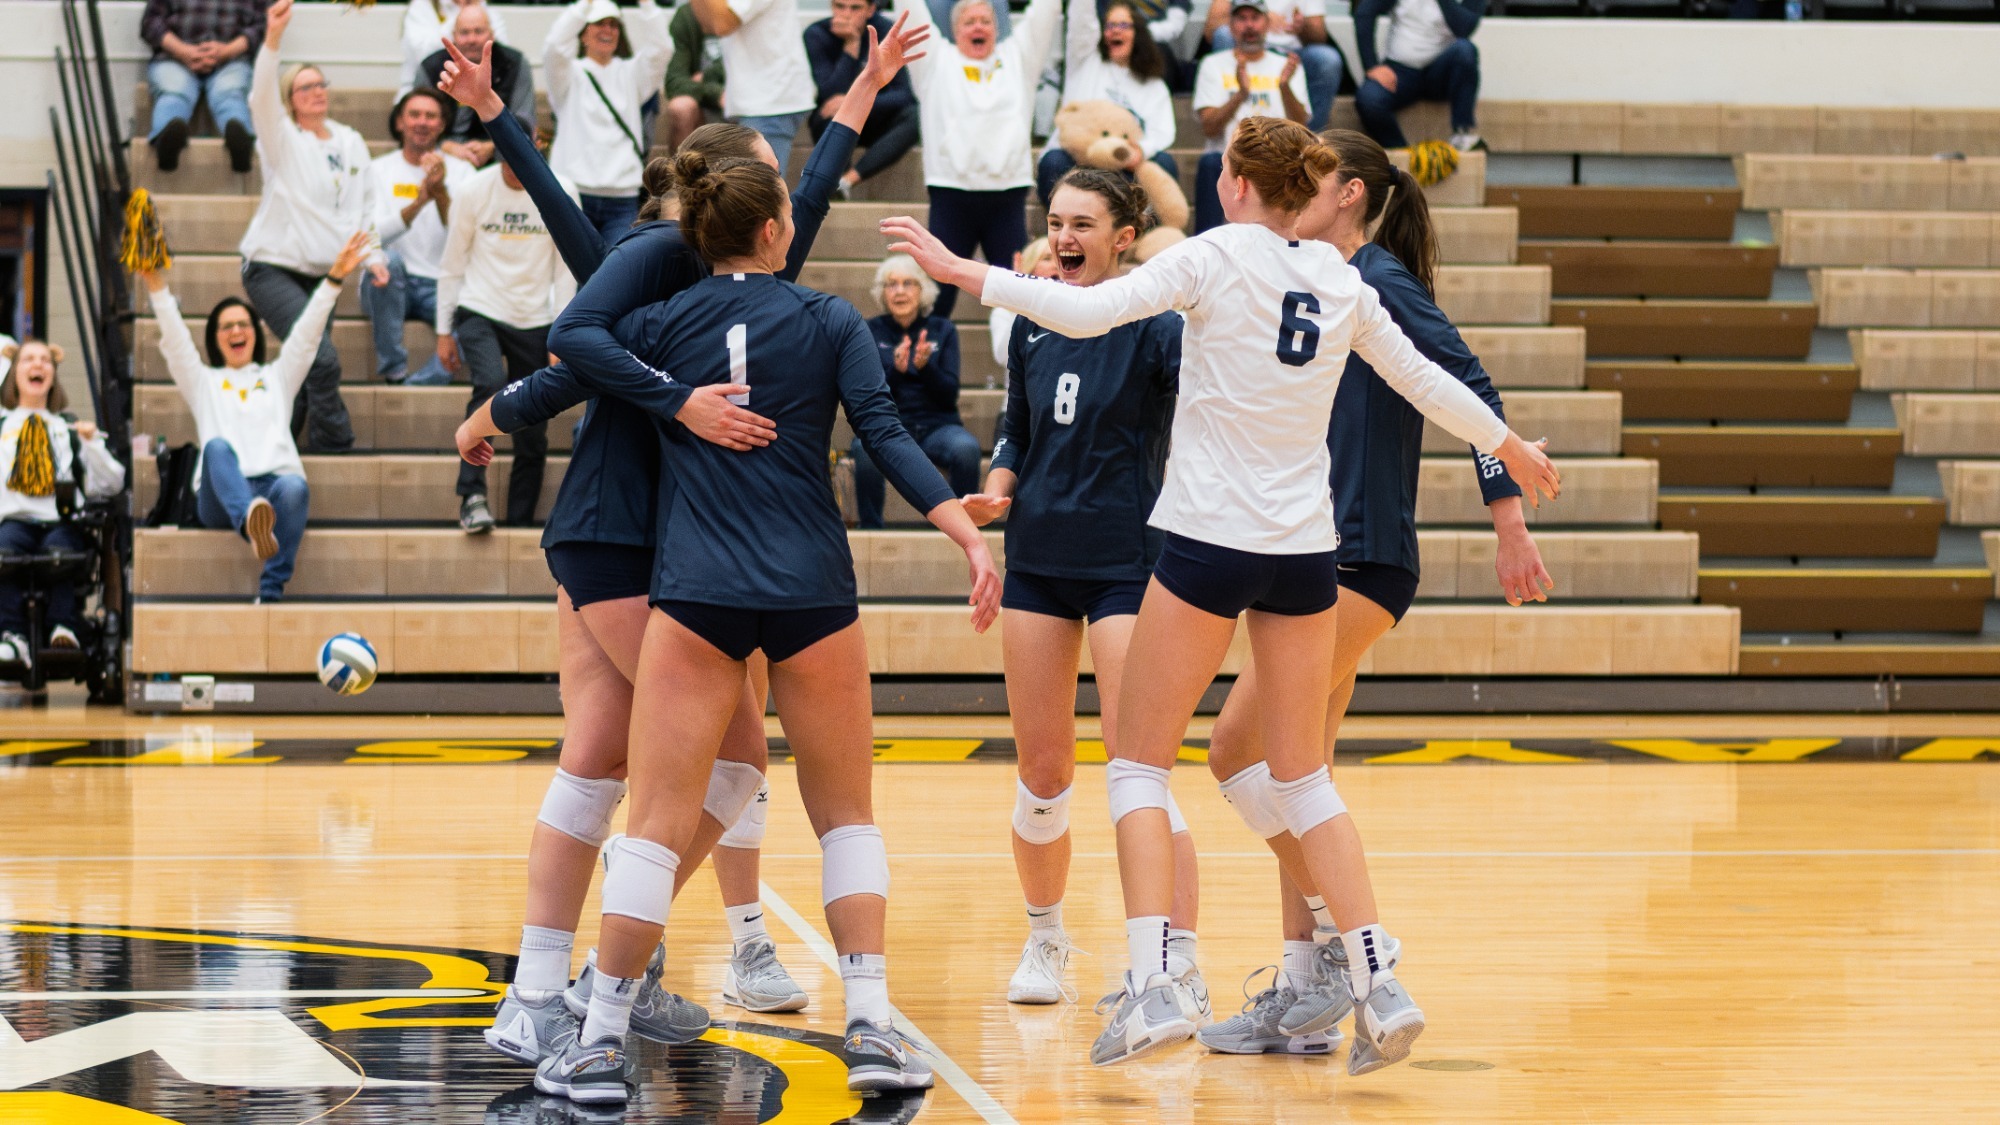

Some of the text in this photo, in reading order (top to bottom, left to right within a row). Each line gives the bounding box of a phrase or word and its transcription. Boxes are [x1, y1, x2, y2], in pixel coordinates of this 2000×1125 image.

[726, 323, 750, 406] 1
[1276, 291, 1321, 367] 6
[1054, 372, 1081, 425] 8
